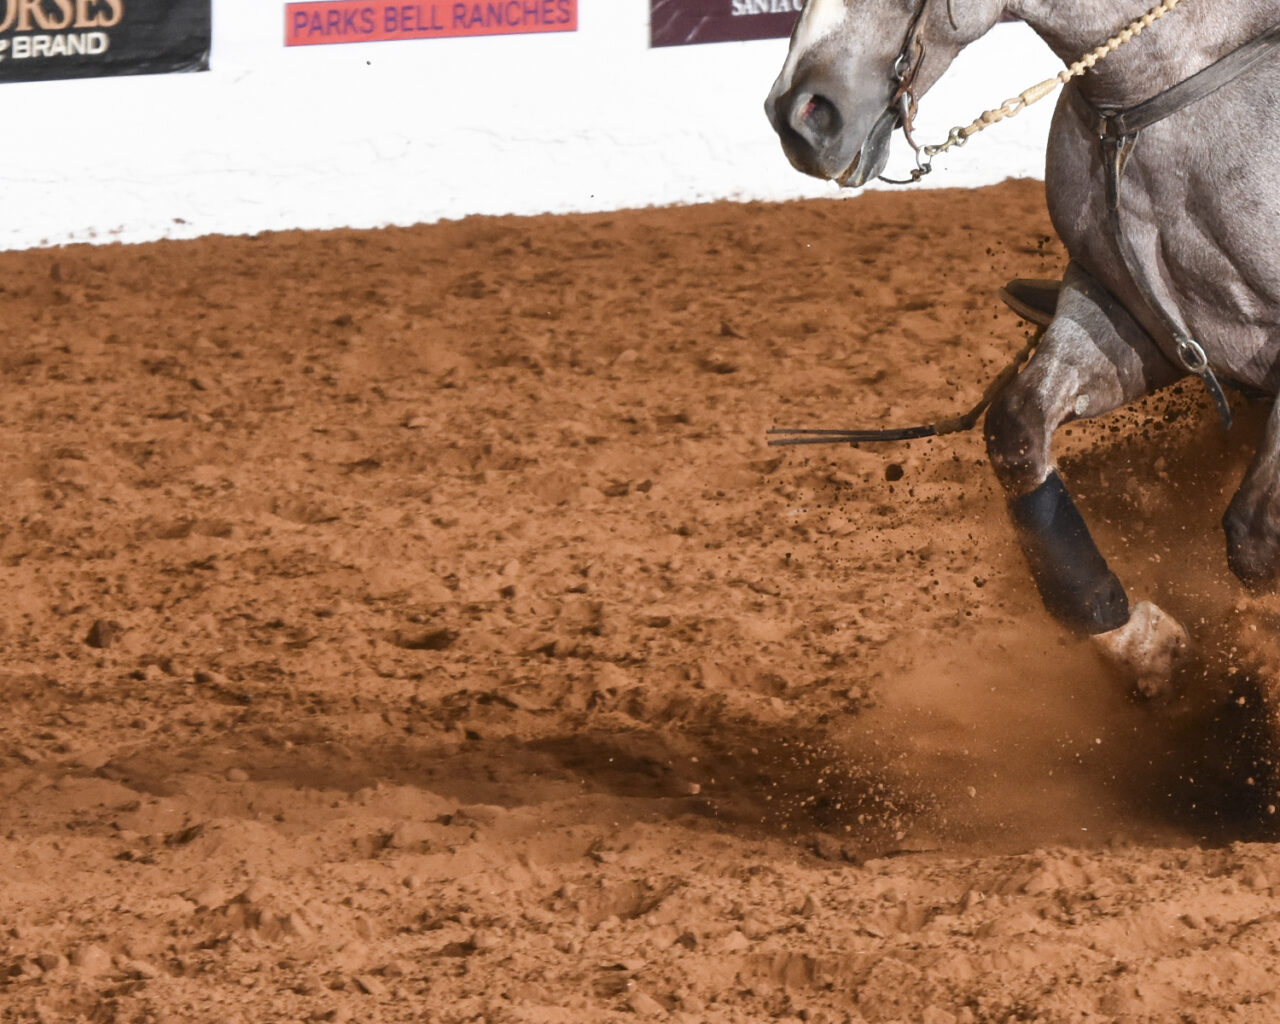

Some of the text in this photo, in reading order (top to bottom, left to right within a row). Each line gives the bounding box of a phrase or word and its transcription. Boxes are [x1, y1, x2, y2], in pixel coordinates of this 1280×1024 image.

[292, 7, 376, 38] PARKS
[384, 4, 444, 33] BELL
[11, 31, 111, 60] BRAND
